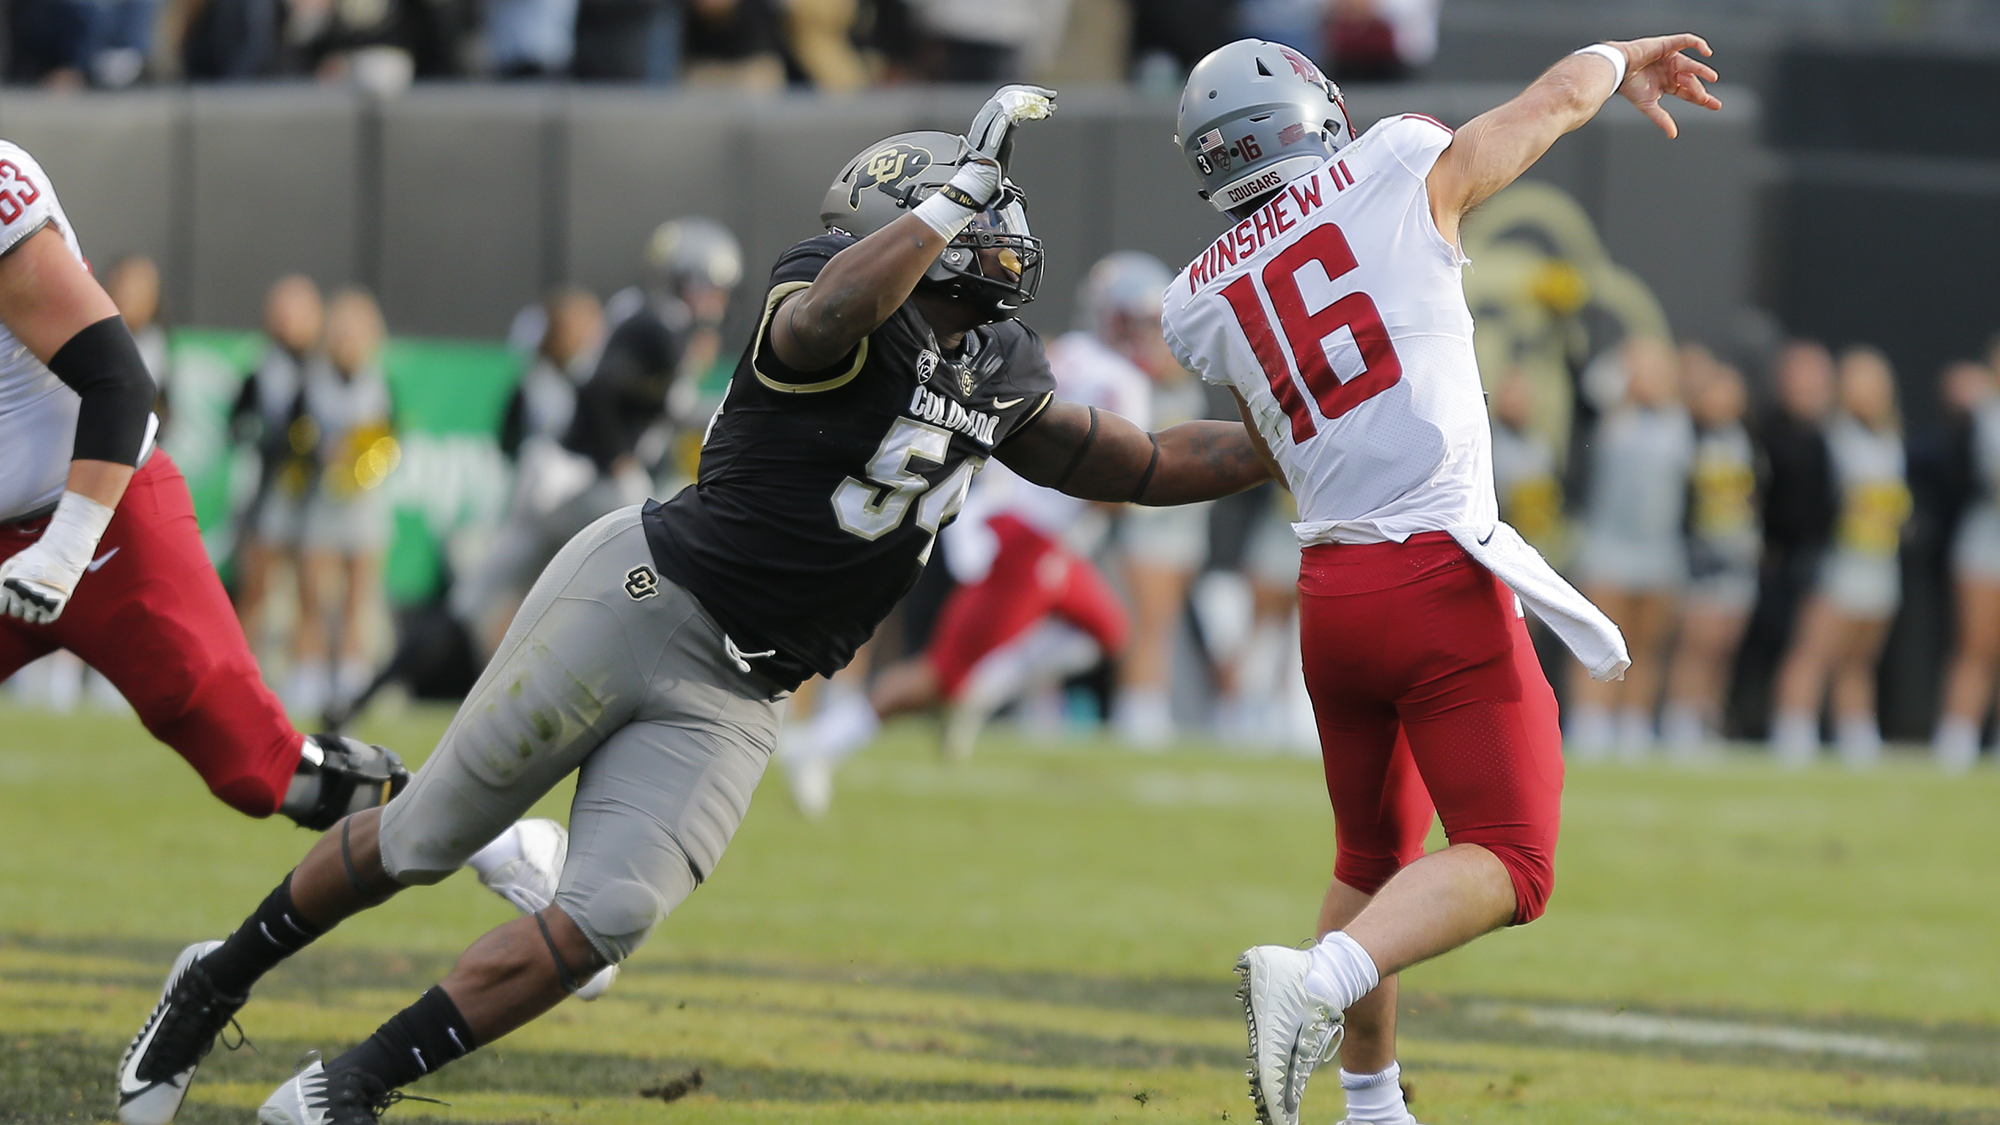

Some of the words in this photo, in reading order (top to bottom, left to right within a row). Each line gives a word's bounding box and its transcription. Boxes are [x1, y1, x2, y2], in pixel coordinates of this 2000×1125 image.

[1197, 155, 1212, 174] 3
[1235, 134, 1263, 163] 16
[867, 149, 909, 182] CU
[1227, 171, 1281, 203] COUGARS
[1189, 175, 1323, 295] MINSHEW
[1329, 160, 1354, 192] II
[1215, 222, 1402, 445] 16
[831, 416, 989, 566] 54
